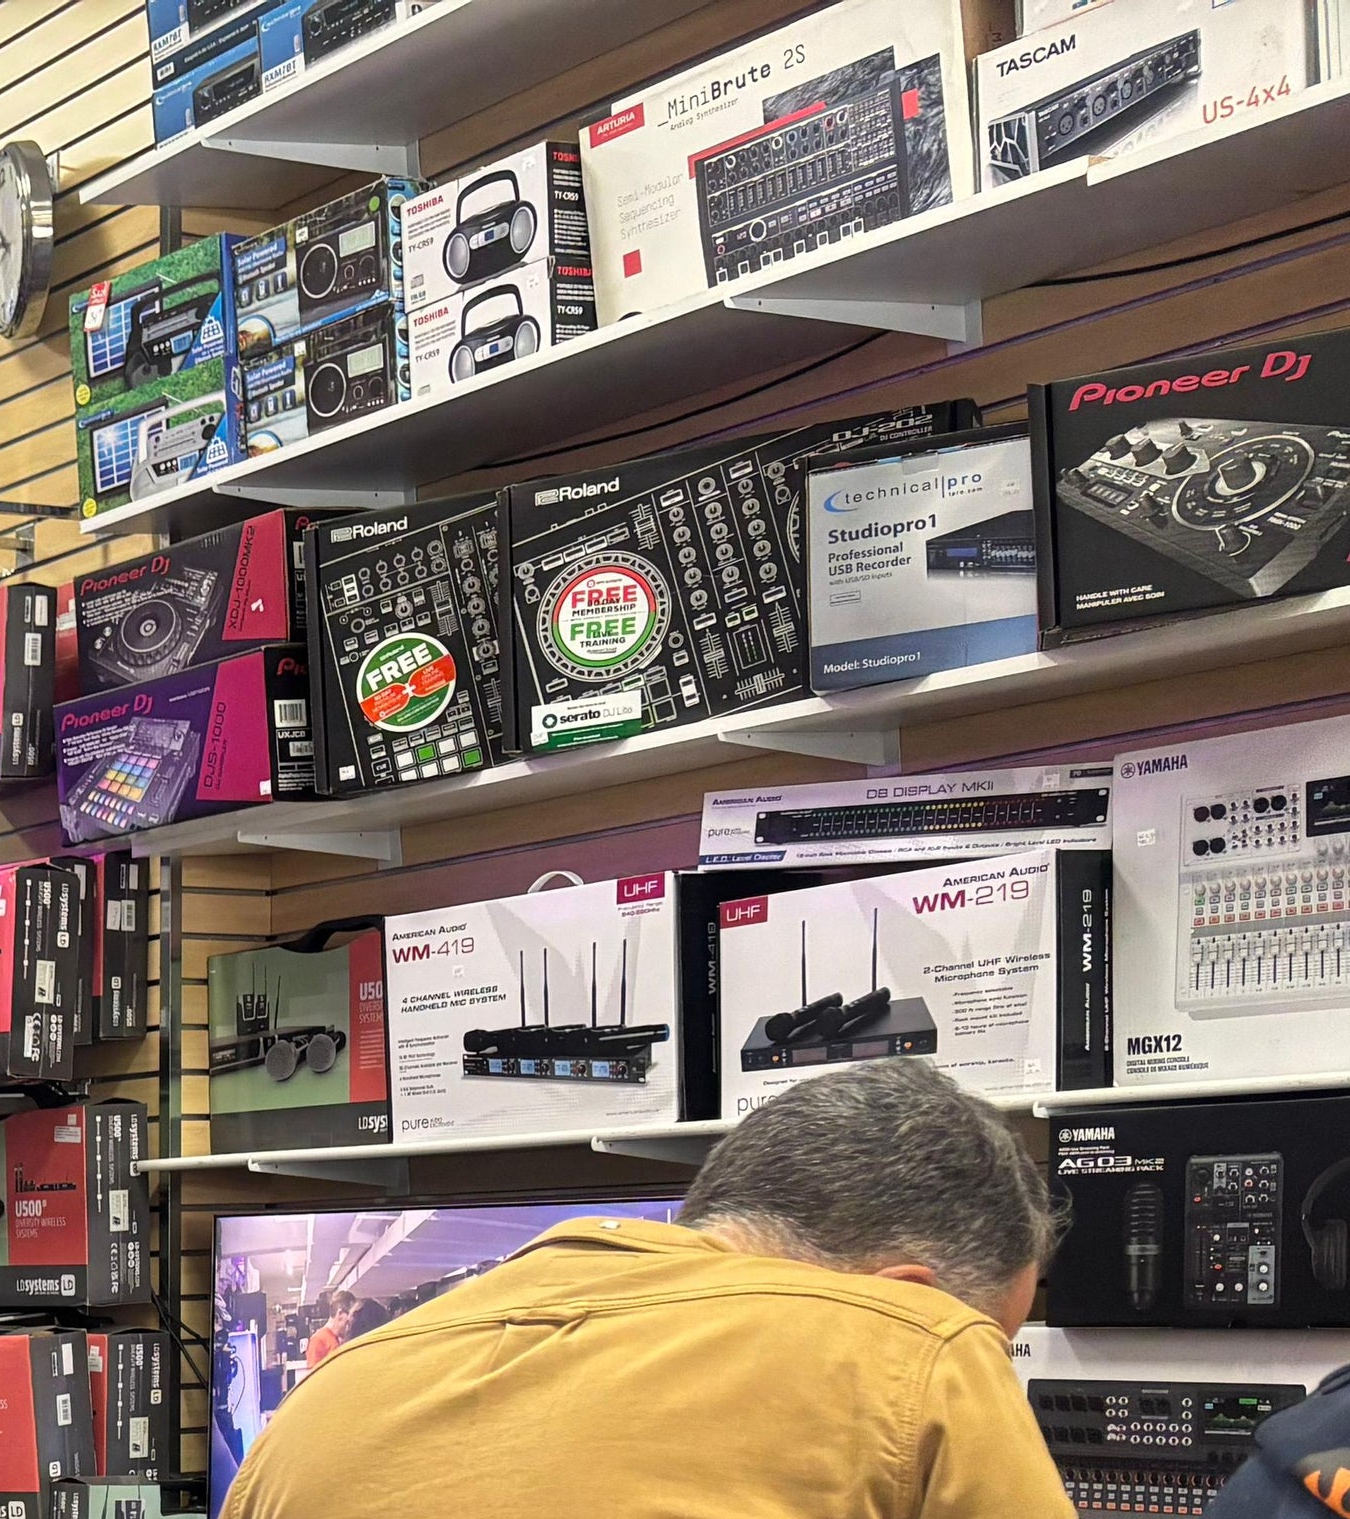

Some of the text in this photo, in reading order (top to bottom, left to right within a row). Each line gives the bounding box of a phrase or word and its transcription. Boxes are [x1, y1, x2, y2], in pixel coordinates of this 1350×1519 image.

[784, 44, 806, 69] 2S
[996, 33, 1077, 79] TASCAM
[1201, 74, 1293, 127] US-4x4
[596, 112, 636, 135] ARTURIA
[406, 194, 444, 217] TOSHIBA
[618, 194, 675, 224] Sequencing
[620, 209, 681, 240] Synthesizer
[413, 307, 449, 328] TOSHIBA
[1068, 366, 1250, 412] Pioneer
[832, 413, 933, 443] DJ-202
[889, 425, 933, 441] CONTROLLER
[559, 477, 620, 503] Roland
[352, 516, 408, 540] Roland
[827, 513, 937, 545] Studiopro1
[827, 542, 904, 563] Professional
[828, 555, 912, 577] USB Recorder
[80, 564, 147, 596] Pioneer
[571, 585, 637, 608] FREE
[1076, 584, 1153, 602] HANDLE WITH CARE
[572, 604, 636, 617] MEMBERSHIP
[570, 617, 636, 641] FREE
[580, 637, 626, 648] TRAINING
[365, 642, 432, 692] FREE
[823, 652, 921, 674] Model: Studiopro1
[61, 700, 129, 732] Pioneer
[559, 709, 601, 725] serato
[1137, 755, 1188, 776] YAMAHA
[893, 782, 957, 798] DISPLAY
[942, 863, 1048, 888] AMERICAN AUDIO
[623, 880, 658, 898] UHF
[912, 880, 1031, 915] WM-219
[726, 904, 761, 923] UHF
[392, 922, 466, 942] AMERICAN AUDIO
[1082, 889, 1093, 973] WM-219
[392, 937, 475, 965] WM-419
[923, 951, 1051, 975] 2-Channel UHF Wireless
[934, 963, 1040, 984] Microphone System
[401, 994, 507, 1013] HANDHELD MIC SYSTEM
[402, 985, 498, 1004] 4 CHANNEL WIRELESS
[1127, 1034, 1182, 1056] MGX12
[402, 1117, 430, 1133] pure
[1072, 1126, 1115, 1142] YAMAHA
[1081, 1166, 1135, 1174] STREAMING
[15, 1216, 66, 1228] DIVERSITY WIRELESS
[15, 1228, 39, 1239] SYSTEMS
